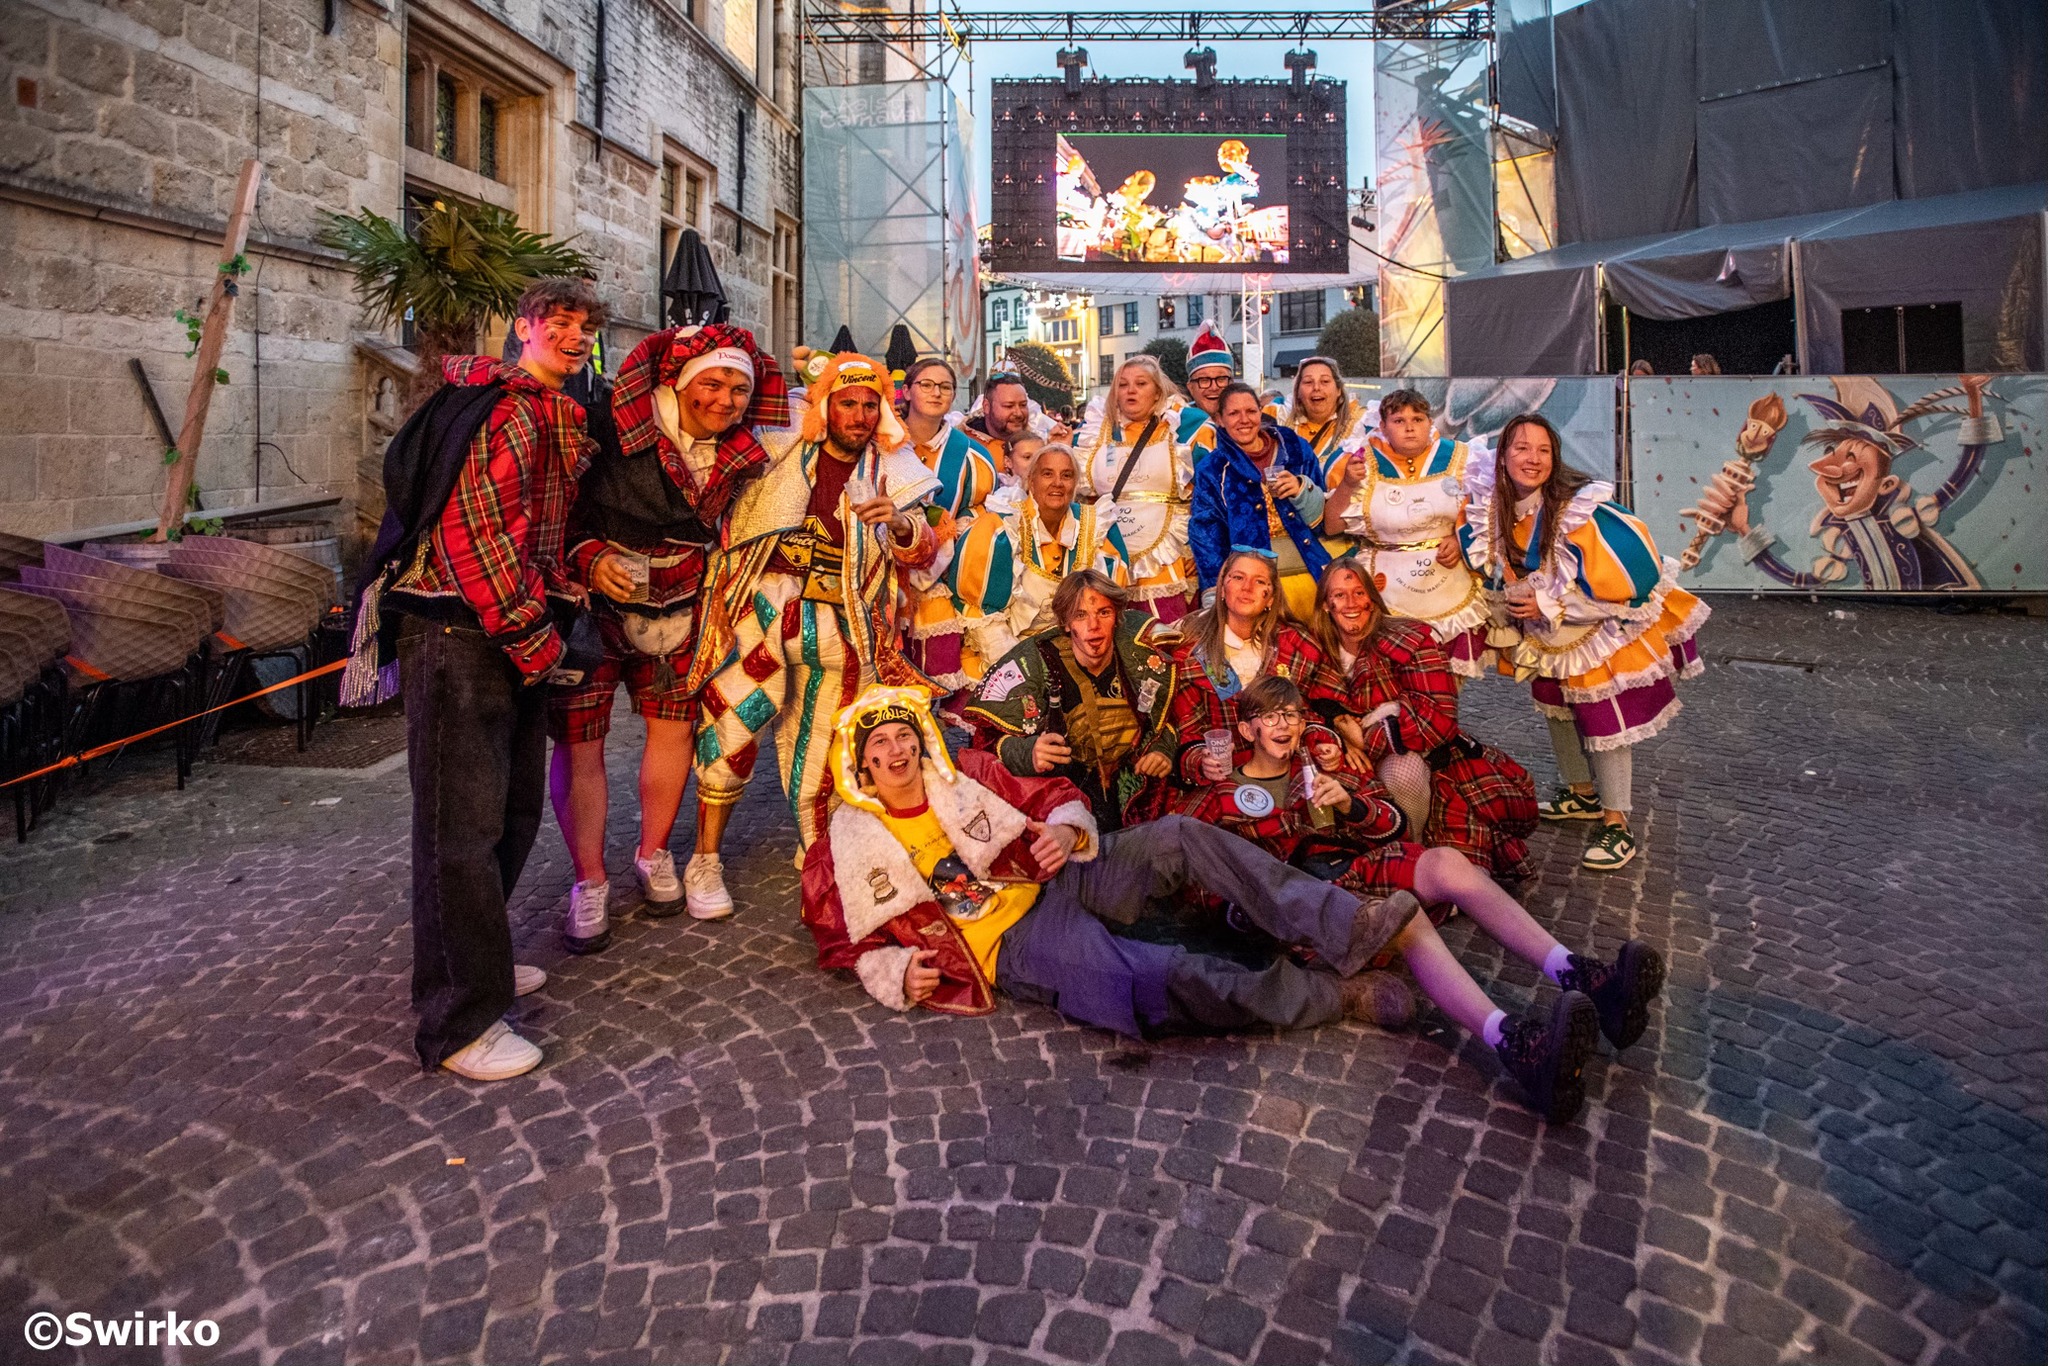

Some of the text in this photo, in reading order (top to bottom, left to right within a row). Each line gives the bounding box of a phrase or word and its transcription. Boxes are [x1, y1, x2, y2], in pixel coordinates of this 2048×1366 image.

[820, 104, 923, 129] Carnaval
[840, 373, 877, 385] Vincent
[1121, 524, 1146, 538] MARCEL
[1416, 558, 1432, 567] 40
[1426, 575, 1449, 593] MARCEL
[1210, 738, 1228, 746] ONLY
